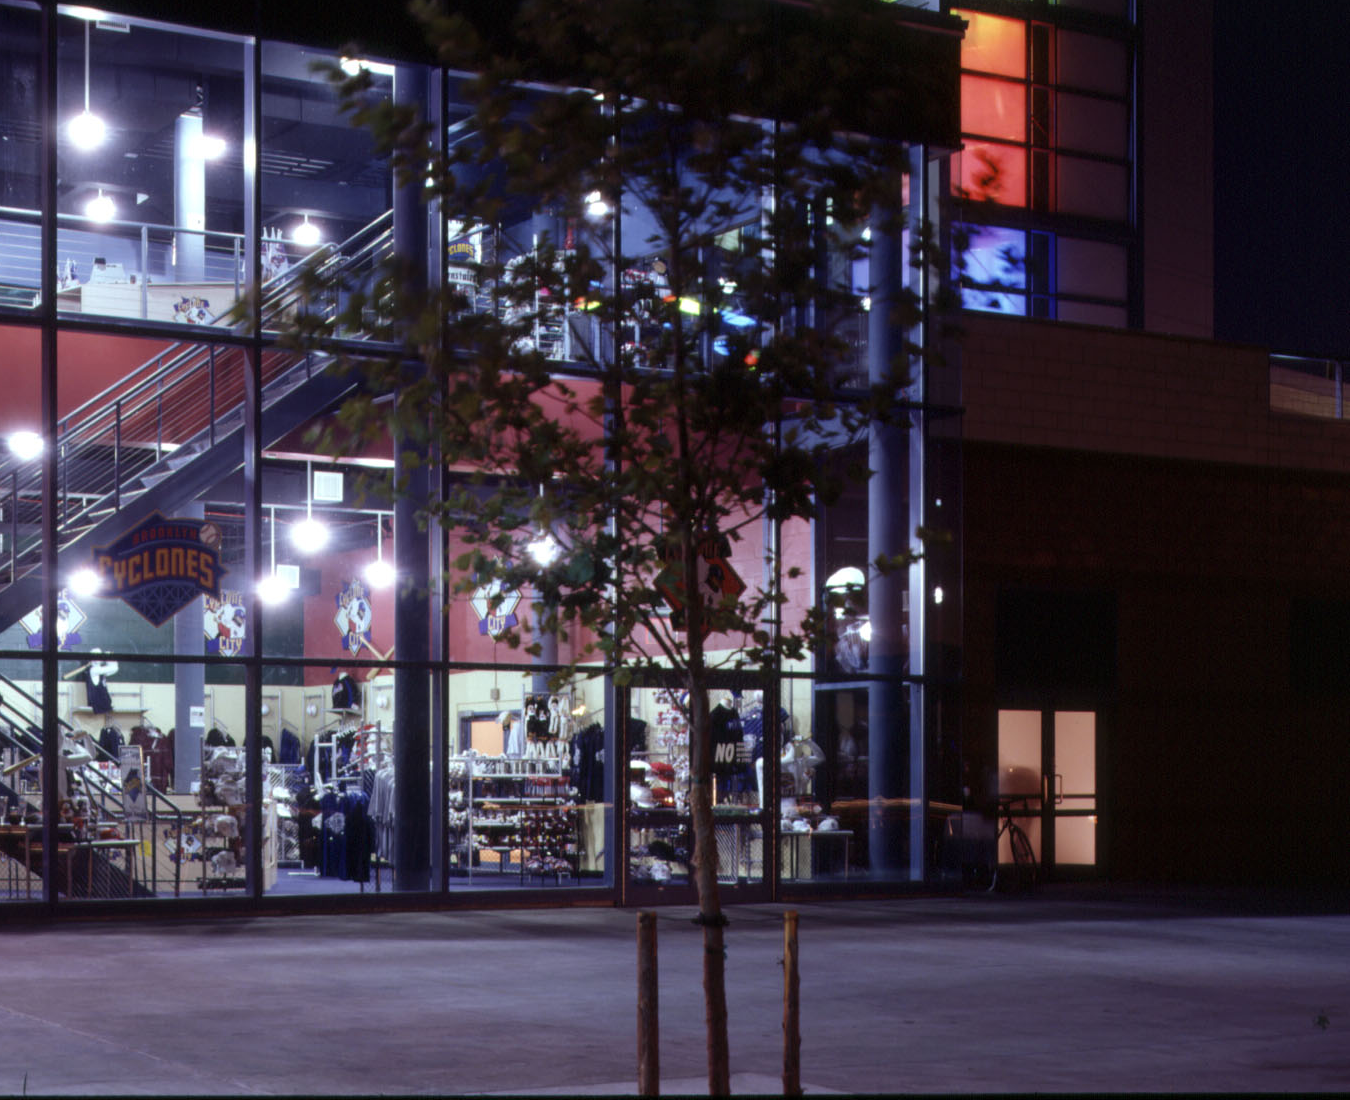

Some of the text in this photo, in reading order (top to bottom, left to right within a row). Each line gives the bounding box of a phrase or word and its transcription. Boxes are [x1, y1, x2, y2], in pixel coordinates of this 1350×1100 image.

[448, 243, 473, 257] CLONES
[132, 526, 197, 545] BROOKLYN
[99, 547, 214, 589] CYCLONES
[219, 635, 242, 650] CITY
[714, 743, 735, 763] NO
